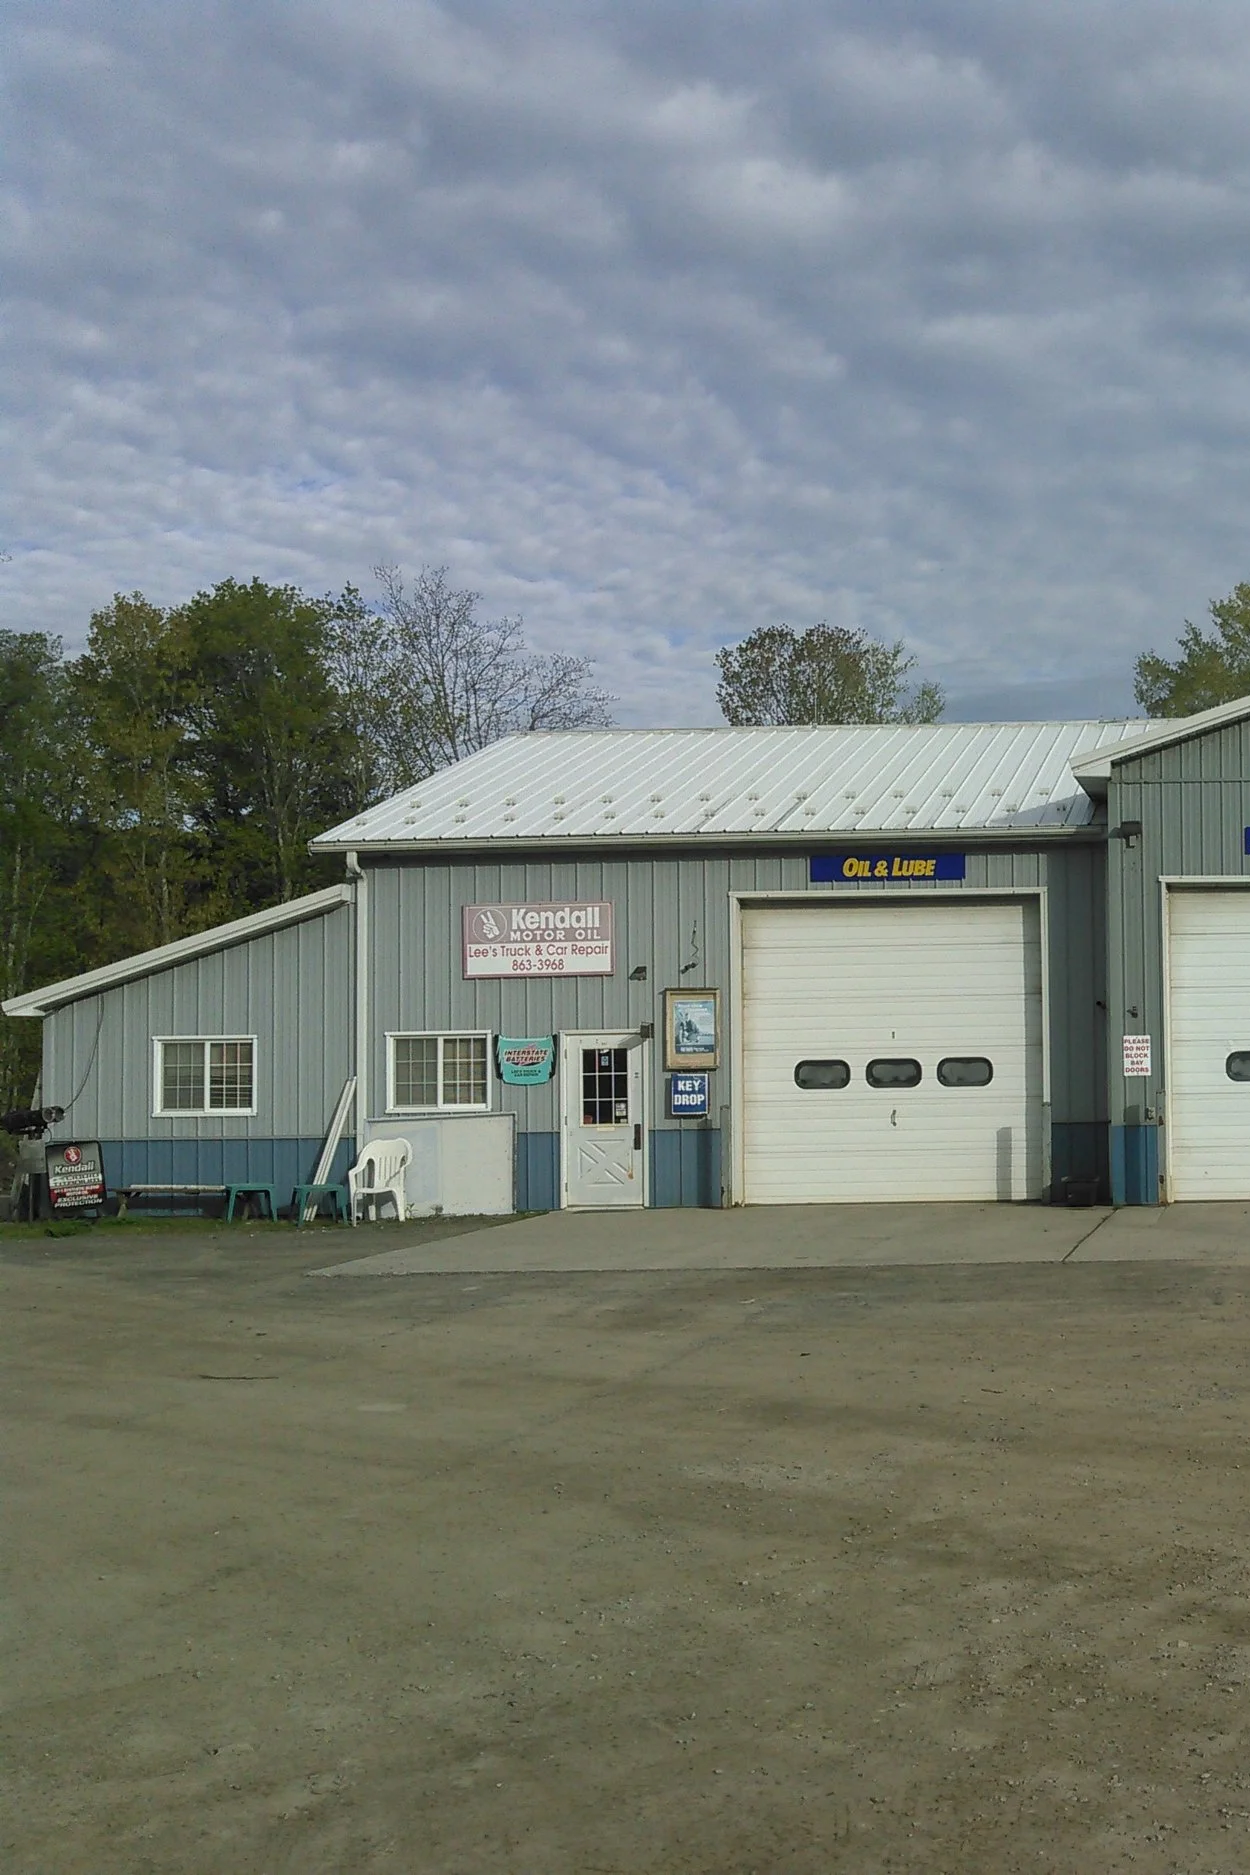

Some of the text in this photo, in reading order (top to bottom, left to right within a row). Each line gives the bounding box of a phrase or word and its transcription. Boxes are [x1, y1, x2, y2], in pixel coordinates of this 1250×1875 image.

[842, 857, 936, 877] OIL & LUBE
[511, 907, 600, 930] Kendall
[510, 929, 601, 941] MOTOR OIL
[468, 944, 609, 958] Lee's Truck & Car Repair
[511, 959, 565, 971] 863-3968
[677, 1080, 701, 1091] KEY
[674, 1094, 705, 1105] DROP
[54, 1161, 94, 1173] Kendall
[54, 1198, 103, 1208] PROTECTION
[57, 1194, 98, 1202] EXCLUSIVE
